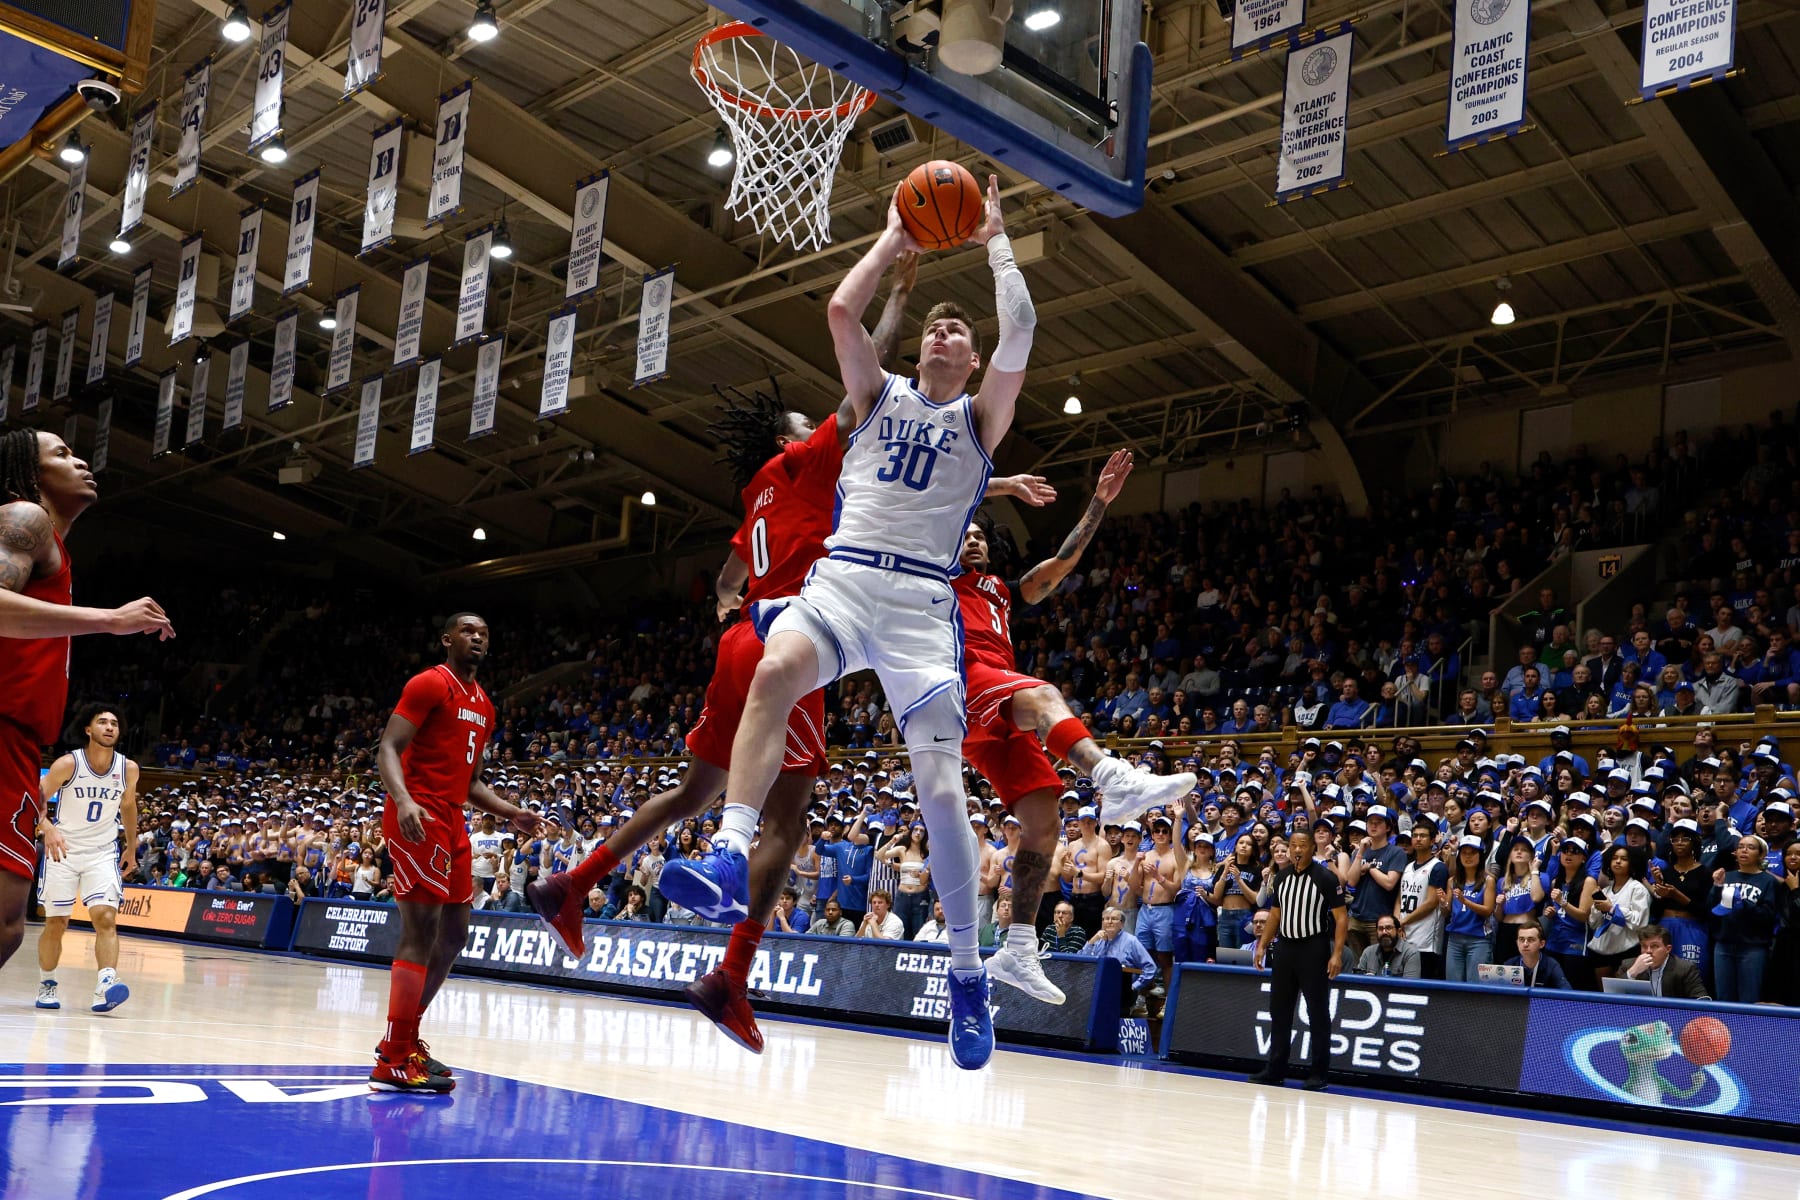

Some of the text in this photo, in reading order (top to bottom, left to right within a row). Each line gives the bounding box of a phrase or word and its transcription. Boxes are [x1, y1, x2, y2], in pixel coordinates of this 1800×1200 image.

[1253, 11, 1281, 31] 1964
[1651, 10, 1726, 44] CHAMPIONS
[1464, 31, 1513, 57] ATLANTIC
[1656, 31, 1720, 57] REGULAR SEASON
[260, 49, 281, 83] 43
[1471, 48, 1505, 68] COAST
[1668, 51, 1704, 72] 2004
[1454, 58, 1523, 89] CONFERENCE
[1456, 73, 1519, 102] CHAMPIONS
[1293, 91, 1336, 114] ATLANTIC
[1465, 91, 1507, 111] TOURNAMENT
[1299, 107, 1328, 125] COAST
[1471, 109, 1498, 126] 2003
[1284, 116, 1344, 142] CONFERENCE
[1286, 130, 1341, 155] CHAMPIONS
[1293, 149, 1329, 166] TOURNAMENT
[1296, 164, 1323, 181] 2002
[576, 221, 597, 238] ATLANTIC
[578, 232, 593, 247] COAST
[570, 239, 600, 260] CONFERENCE
[570, 250, 598, 271] CHAMPIONS
[464, 271, 484, 286] ATLANTIC
[459, 288, 486, 306] CONFERENCE
[466, 282, 480, 295] COAST
[404, 309, 417, 320] COAST
[459, 299, 483, 315] CHAMPIONS
[400, 316, 423, 331] CONFERENCE
[646, 323, 660, 335] COAST
[398, 326, 420, 341] CHAMPIONS
[877, 416, 959, 455] DUKE
[877, 441, 938, 491] 30
[752, 516, 770, 578] 0
[1602, 560, 1617, 578] 14
[457, 707, 487, 729] LOUISVILLE
[466, 730, 477, 765] 5
[74, 785, 122, 801] DUKE
[86, 801, 103, 823] 0
[1401, 880, 1423, 895] Duke
[211, 898, 225, 910] Best
[237, 900, 255, 912] Ever?
[1400, 895, 1418, 914] 30
[216, 911, 233, 924] ZERO
[233, 913, 257, 926] SUGAR
[325, 906, 388, 924] CELEBRATING
[336, 921, 369, 937] BLACK
[328, 935, 370, 952] HISTORY
[1682, 944, 1702, 955] DUKE
[587, 935, 823, 996] BASKETALL
[1119, 1025, 1147, 1042] OACH
[1120, 1039, 1145, 1054] TIME
